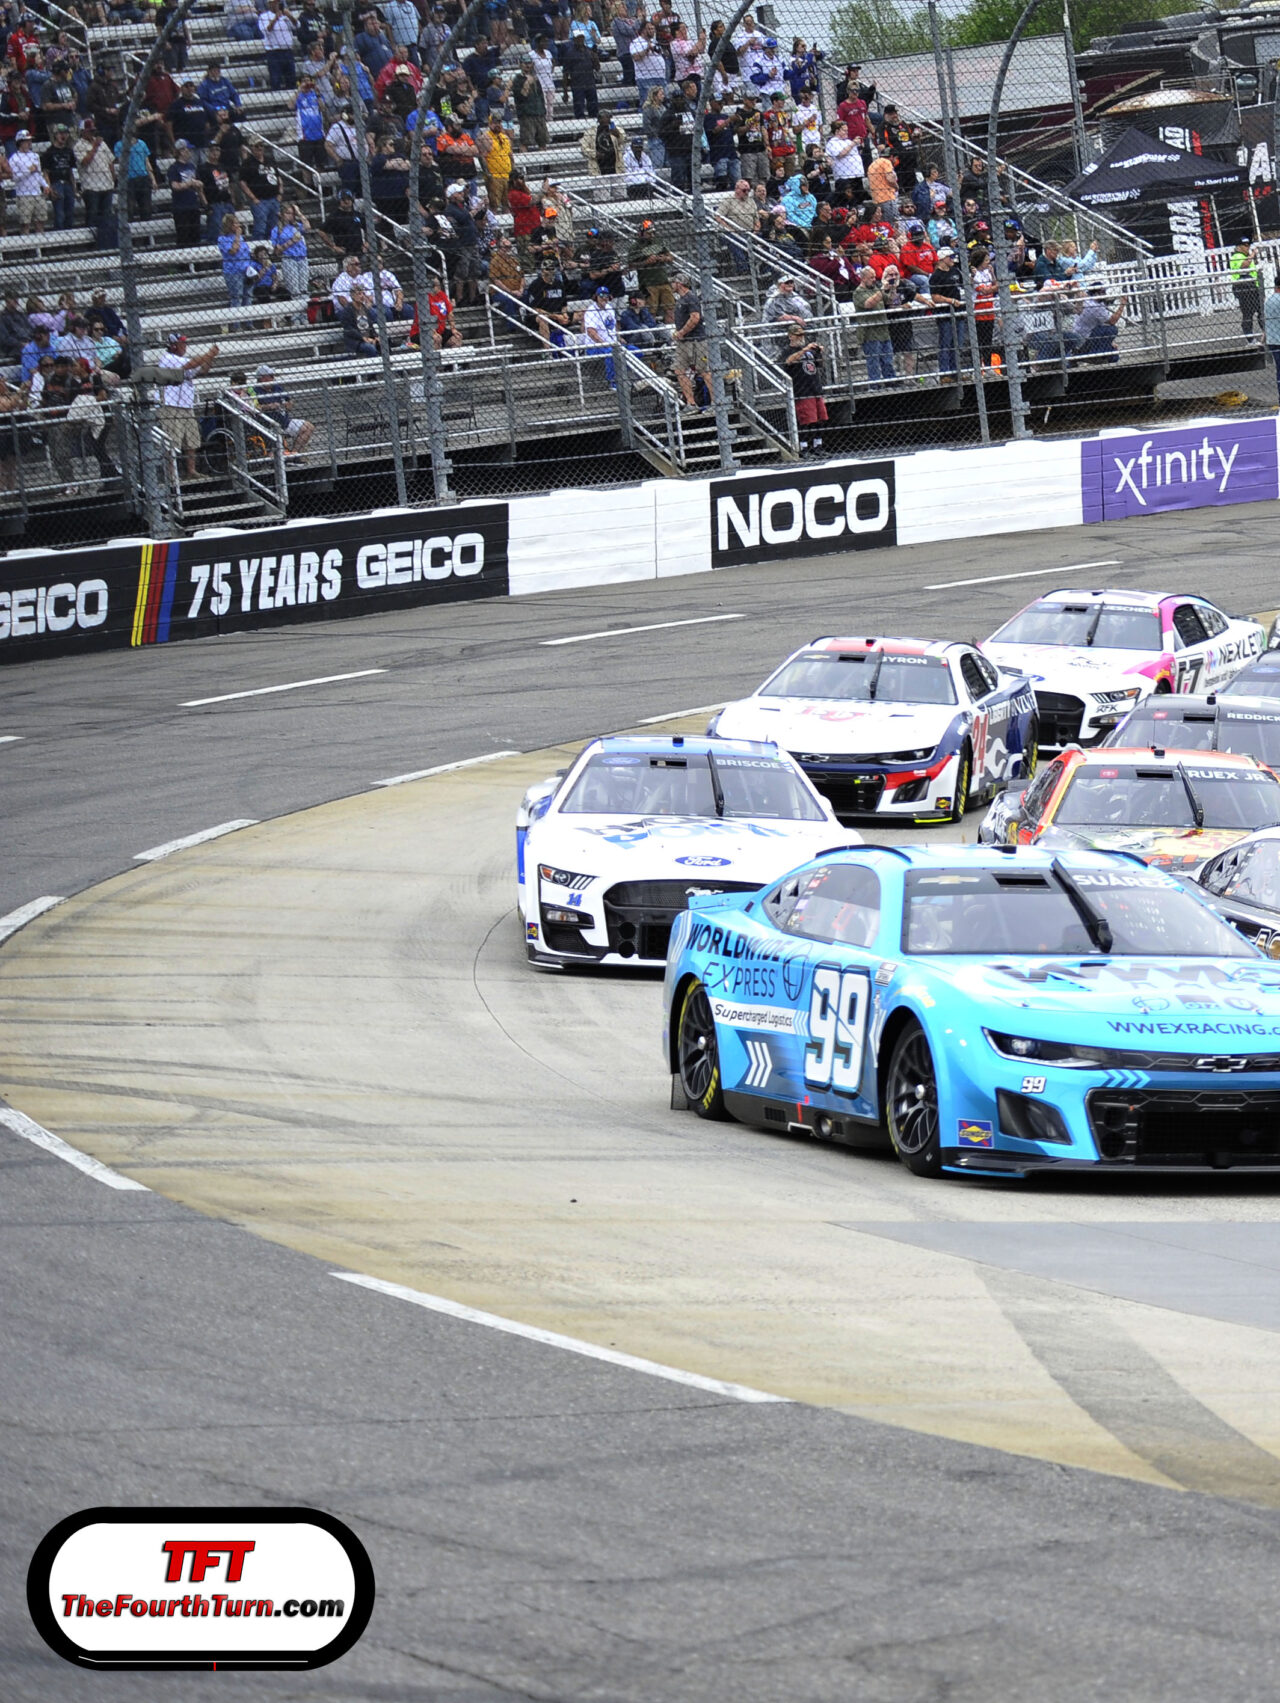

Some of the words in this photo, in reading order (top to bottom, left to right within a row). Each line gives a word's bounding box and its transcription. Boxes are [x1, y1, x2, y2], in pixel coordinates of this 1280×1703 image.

[1113, 436, 1241, 507] xfinity
[716, 476, 889, 552] NOCO
[186, 561, 232, 619] 75
[239, 547, 344, 612] YEARS
[356, 532, 486, 591] GEICO
[881, 654, 928, 666] BYRON
[1095, 703, 1119, 714] RFK
[716, 758, 781, 769] BRISCOE
[566, 892, 583, 907] 14
[686, 922, 793, 963] WORLDWIDE
[701, 961, 777, 999] EXPRESS
[714, 1003, 768, 1027] Supercharged
[768, 1010, 793, 1028] Logistics
[804, 960, 871, 1100] 99
[1021, 1075, 1048, 1094] 99
